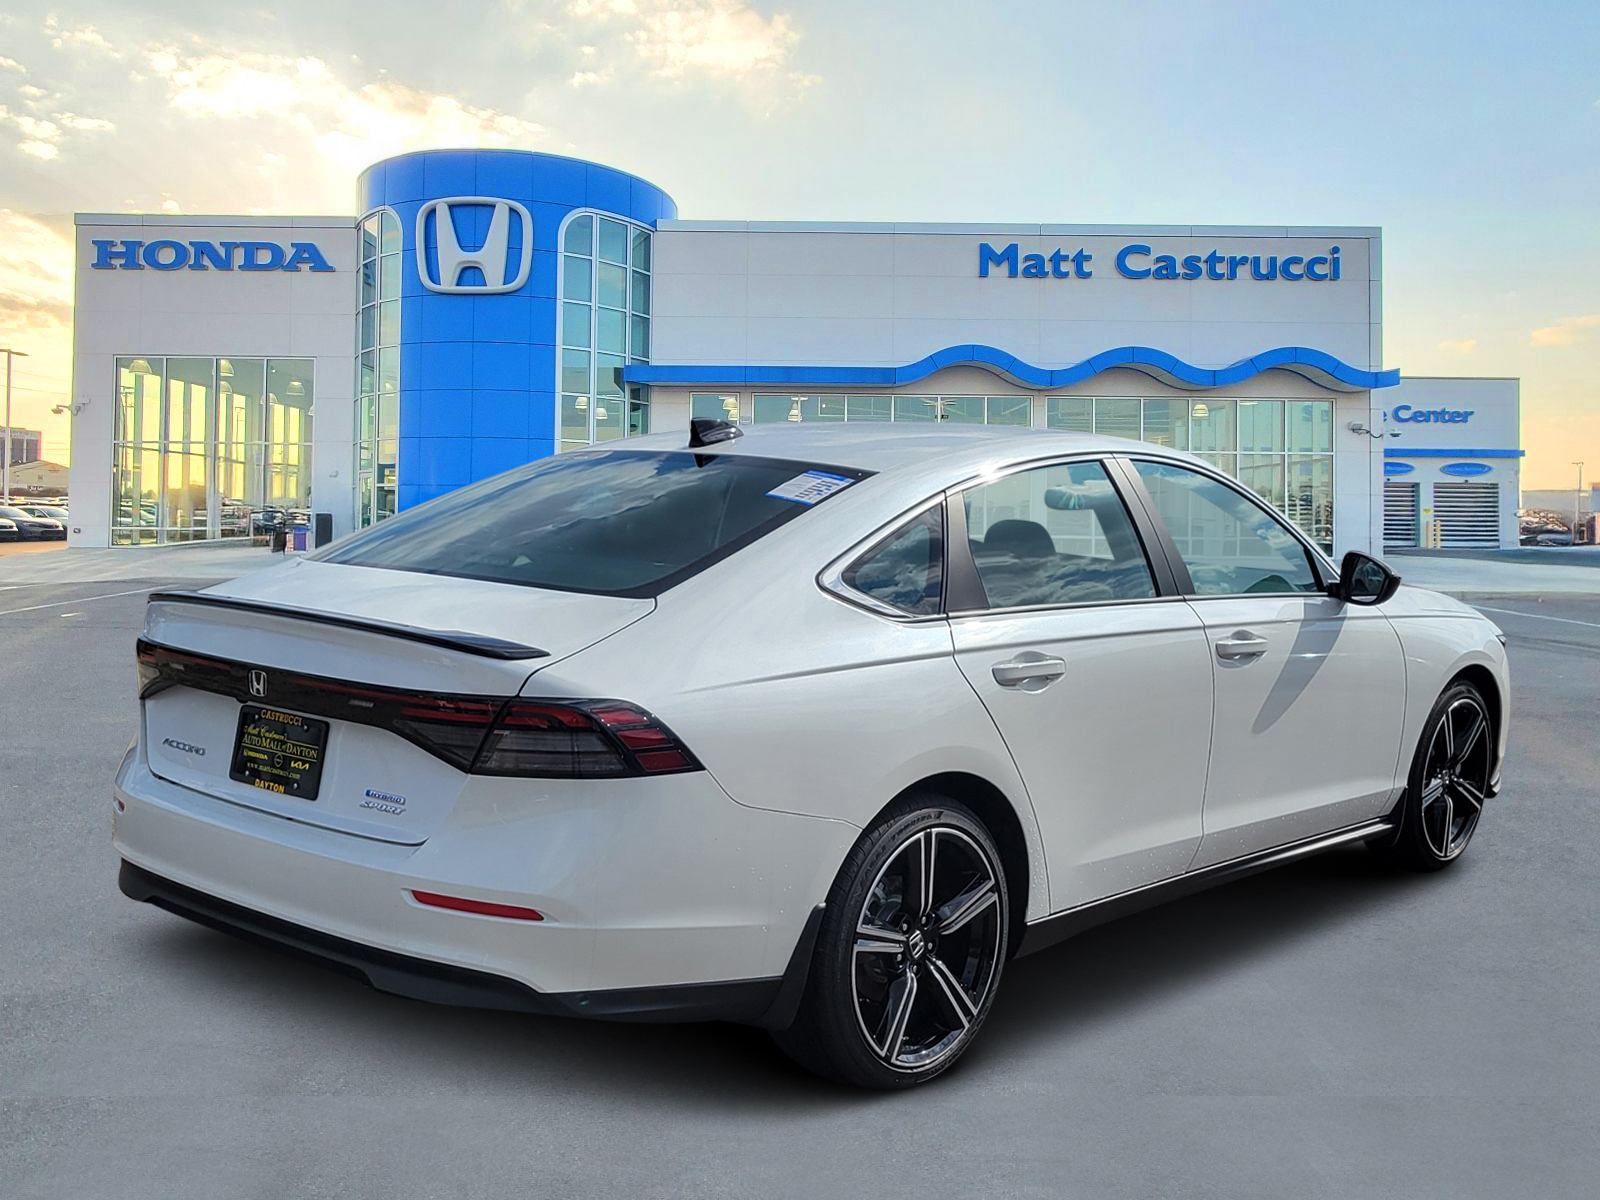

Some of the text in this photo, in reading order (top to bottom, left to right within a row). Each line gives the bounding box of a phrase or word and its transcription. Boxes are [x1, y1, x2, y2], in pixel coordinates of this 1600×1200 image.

[92, 239, 336, 272] HONDA
[978, 242, 1342, 281] Matt Castrucci
[1392, 404, 1474, 424] Center
[261, 710, 302, 726] CASTRUCCI
[162, 737, 206, 756] ACCORD
[255, 779, 284, 793] DAYTON
[370, 791, 403, 804] HYBRID
[359, 800, 406, 815] SPORT
